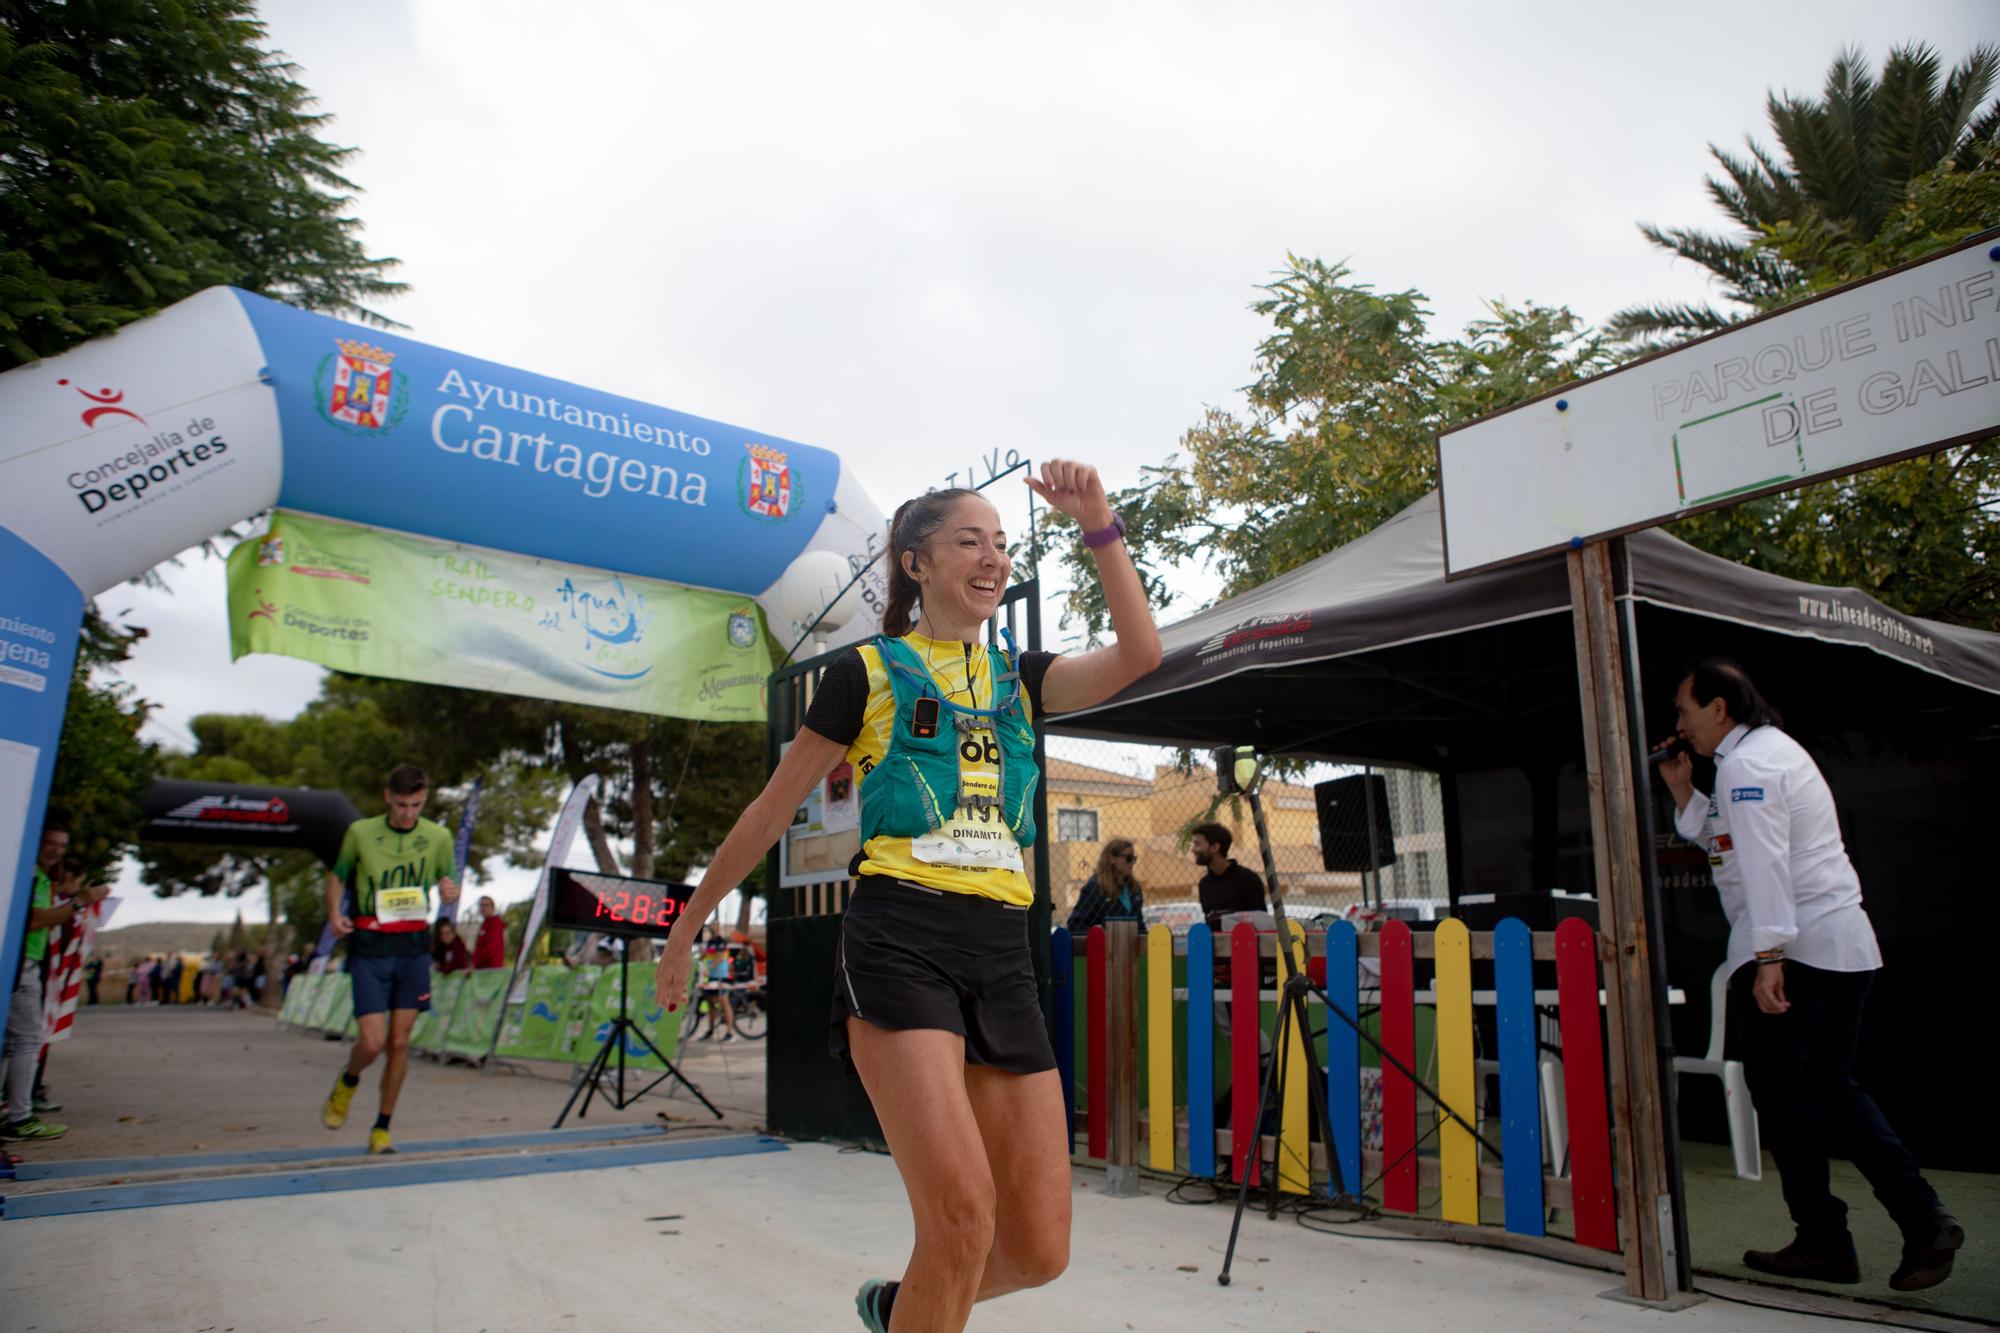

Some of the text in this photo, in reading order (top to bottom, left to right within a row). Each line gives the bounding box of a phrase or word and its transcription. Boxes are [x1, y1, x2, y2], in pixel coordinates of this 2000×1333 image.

[1652, 270, 2000, 421] PARQUE INF
[186, 416, 216, 438] de
[437, 368, 712, 457] Ayuntamiento
[1762, 387, 1843, 448] DE
[78, 434, 228, 514] Deportes
[431, 403, 708, 507] Cartagena
[430, 579, 537, 612] SENDERO
[284, 613, 369, 641] Deportes
[595, 891, 687, 927] 1:28:2
